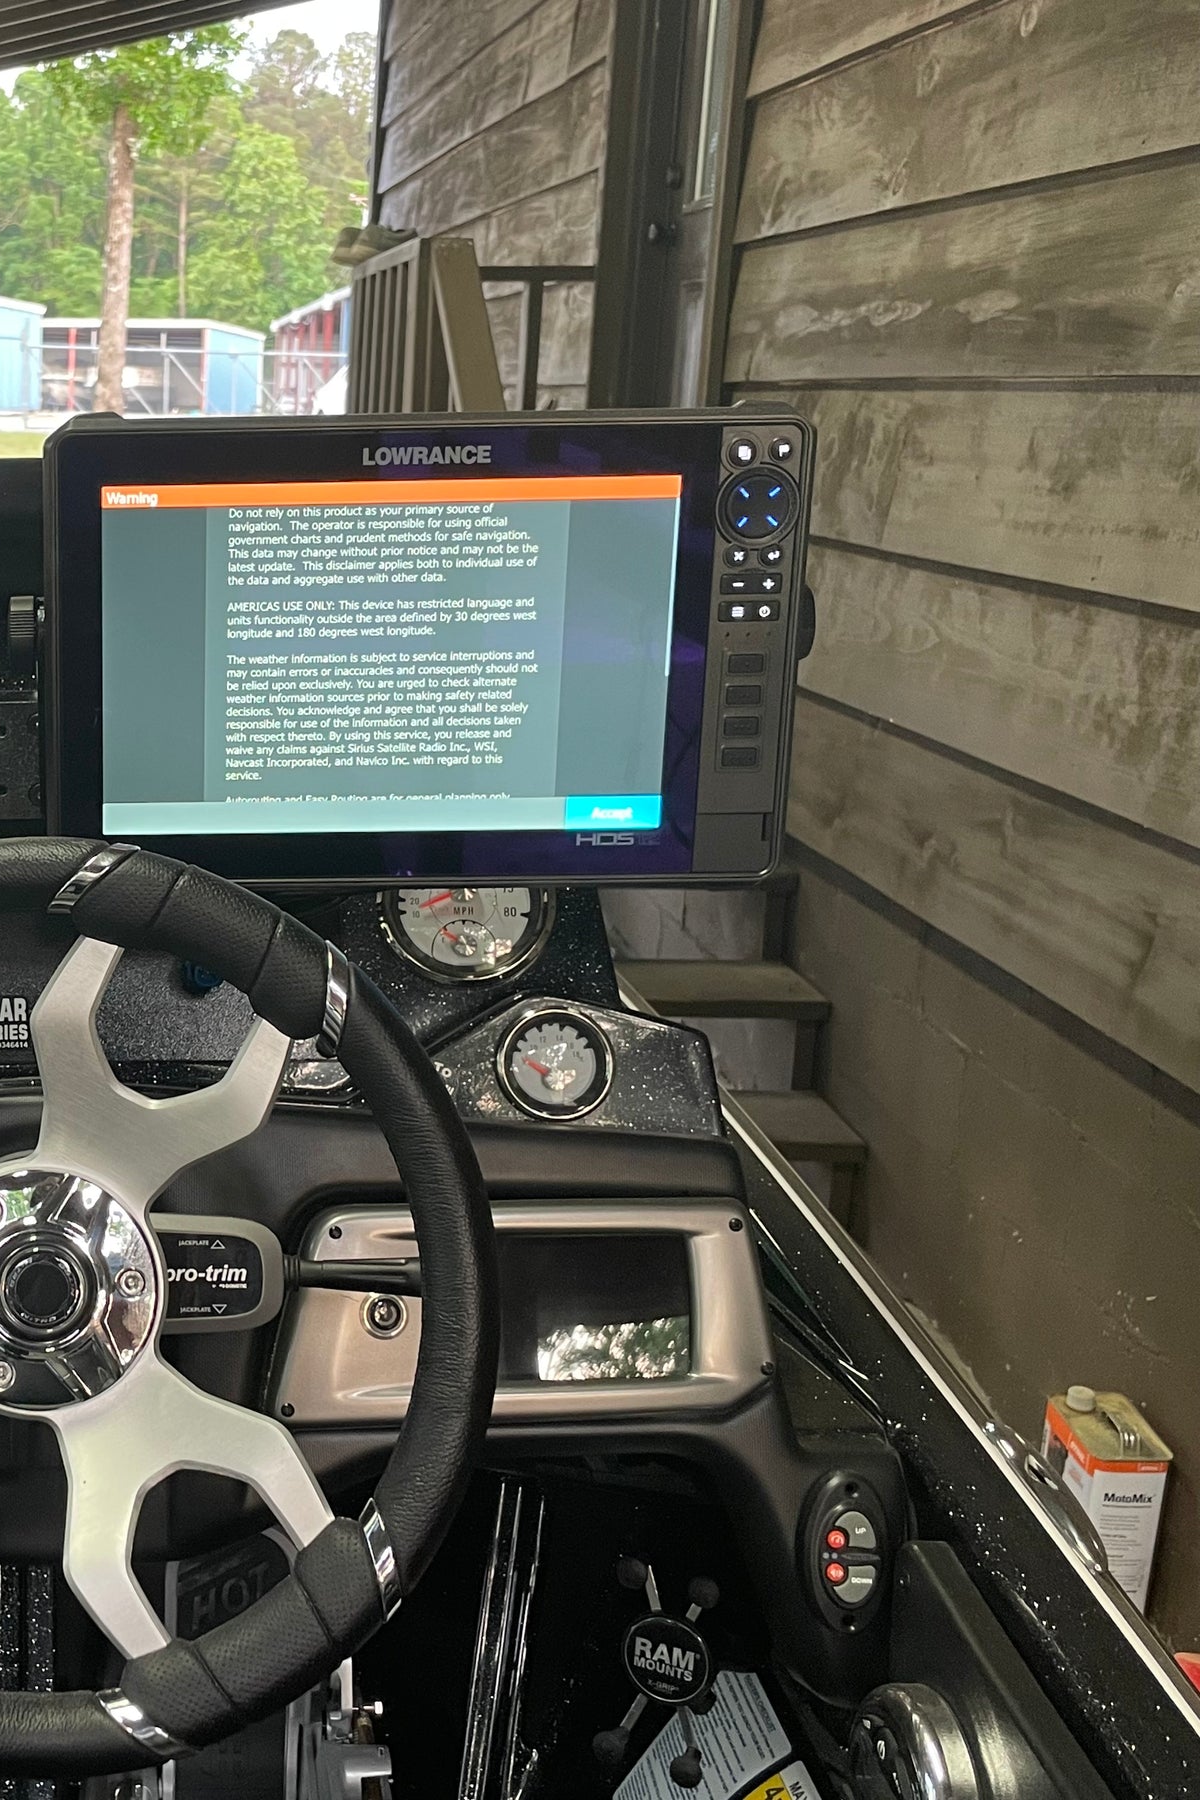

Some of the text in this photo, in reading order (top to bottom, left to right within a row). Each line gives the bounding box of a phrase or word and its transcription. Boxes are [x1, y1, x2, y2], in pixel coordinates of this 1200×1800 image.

[362, 445, 491, 466] LOWRANCE
[106, 492, 158, 507] Warning
[229, 504, 494, 520] Do not rely on this product as your primary source of
[228, 516, 507, 533] navigation. The operator is responsible for using official
[228, 529, 530, 547] government charts and prudent methods for safe navigation.
[228, 543, 538, 560] This data may change without prior notice and may not be the
[228, 556, 537, 573] latest update. This disclaimer applies both to individual use of
[227, 571, 446, 586] the data and aggregate use with other data.
[227, 596, 534, 611] AMERICAS USE ONLY: This device has restricted language and
[227, 610, 536, 628] units functionality outside the area defined by 30 degrees west
[591, 806, 633, 820] Accept
[453, 907, 474, 915] MPH
[503, 907, 517, 917] 80
[178, 1239, 209, 1247] JACKPLATE
[1103, 1492, 1153, 1504] MotoMix
[855, 1526, 867, 1534] UP
[851, 1576, 873, 1584] DOWN
[633, 1636, 696, 1672] RAM
[633, 1655, 694, 1682] MOUNTS
